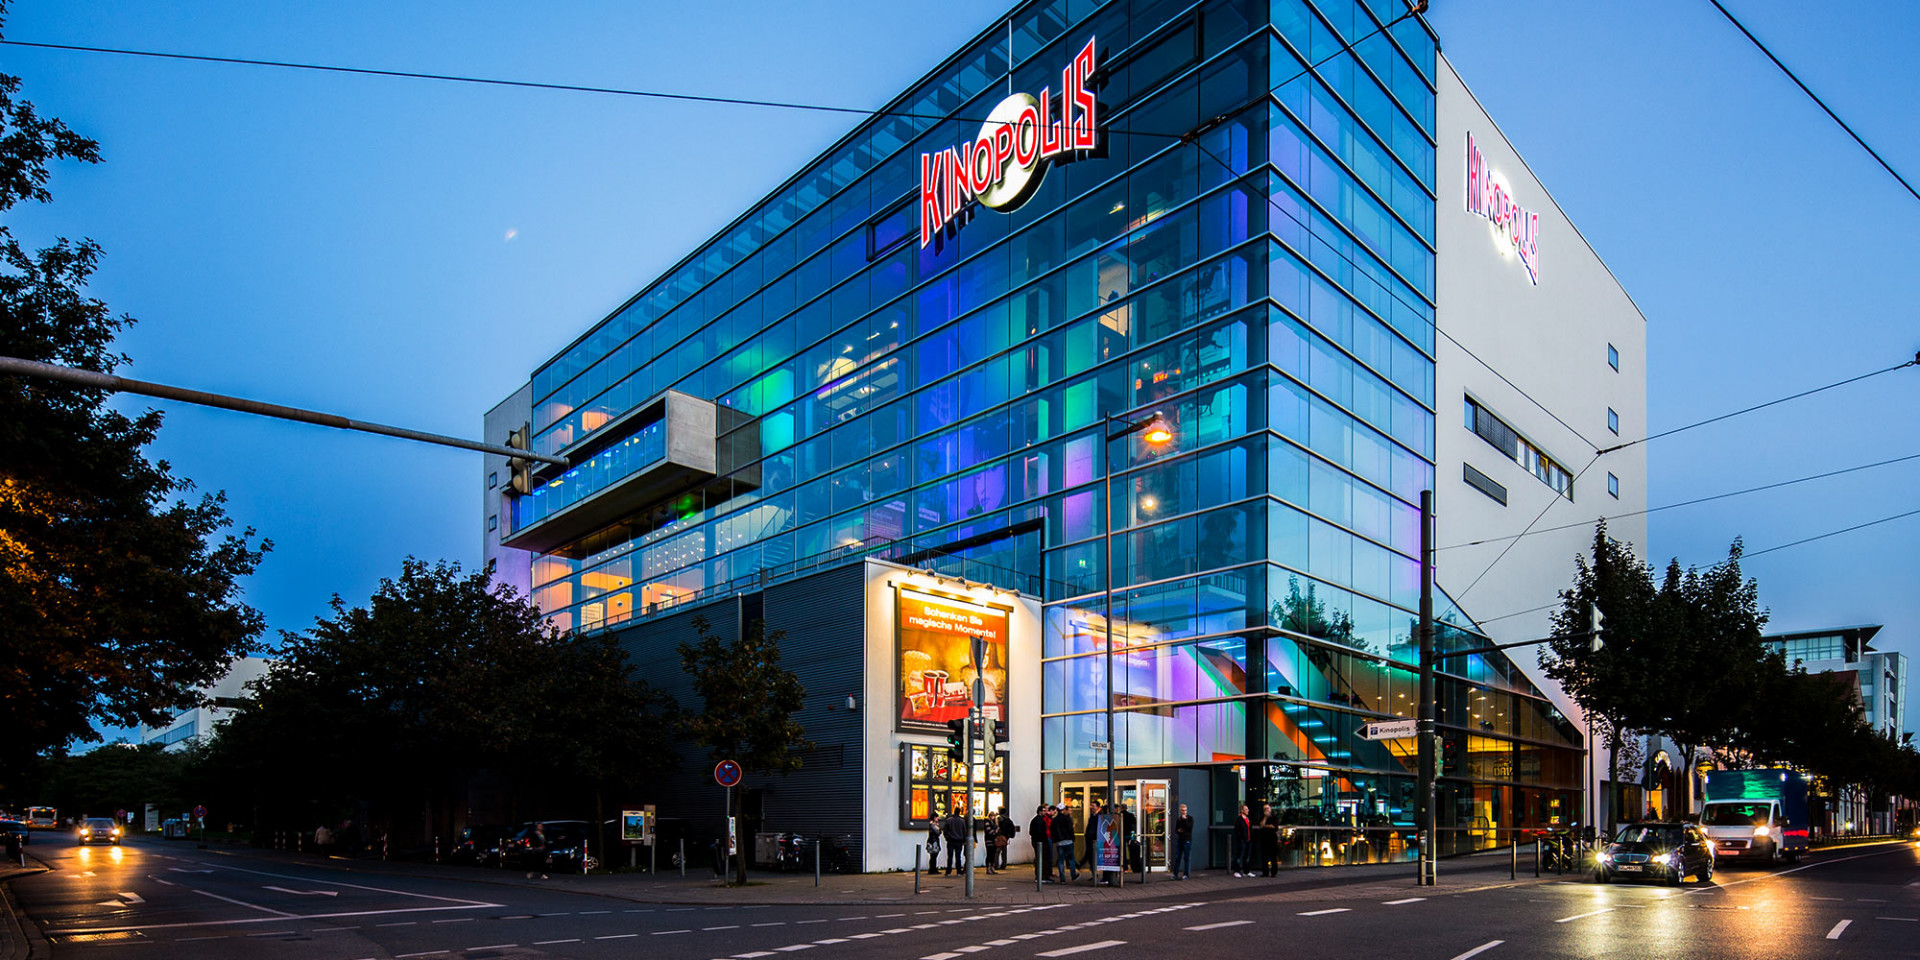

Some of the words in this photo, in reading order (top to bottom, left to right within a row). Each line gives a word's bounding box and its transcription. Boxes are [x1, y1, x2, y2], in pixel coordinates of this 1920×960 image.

[921, 34, 1096, 250] KINOPOLIS
[1466, 131, 1538, 285] KINOPOLIS
[909, 617, 952, 631] magische
[954, 624, 996, 638] Momente!
[924, 607, 967, 622] Schenken
[969, 615, 983, 625] Sie
